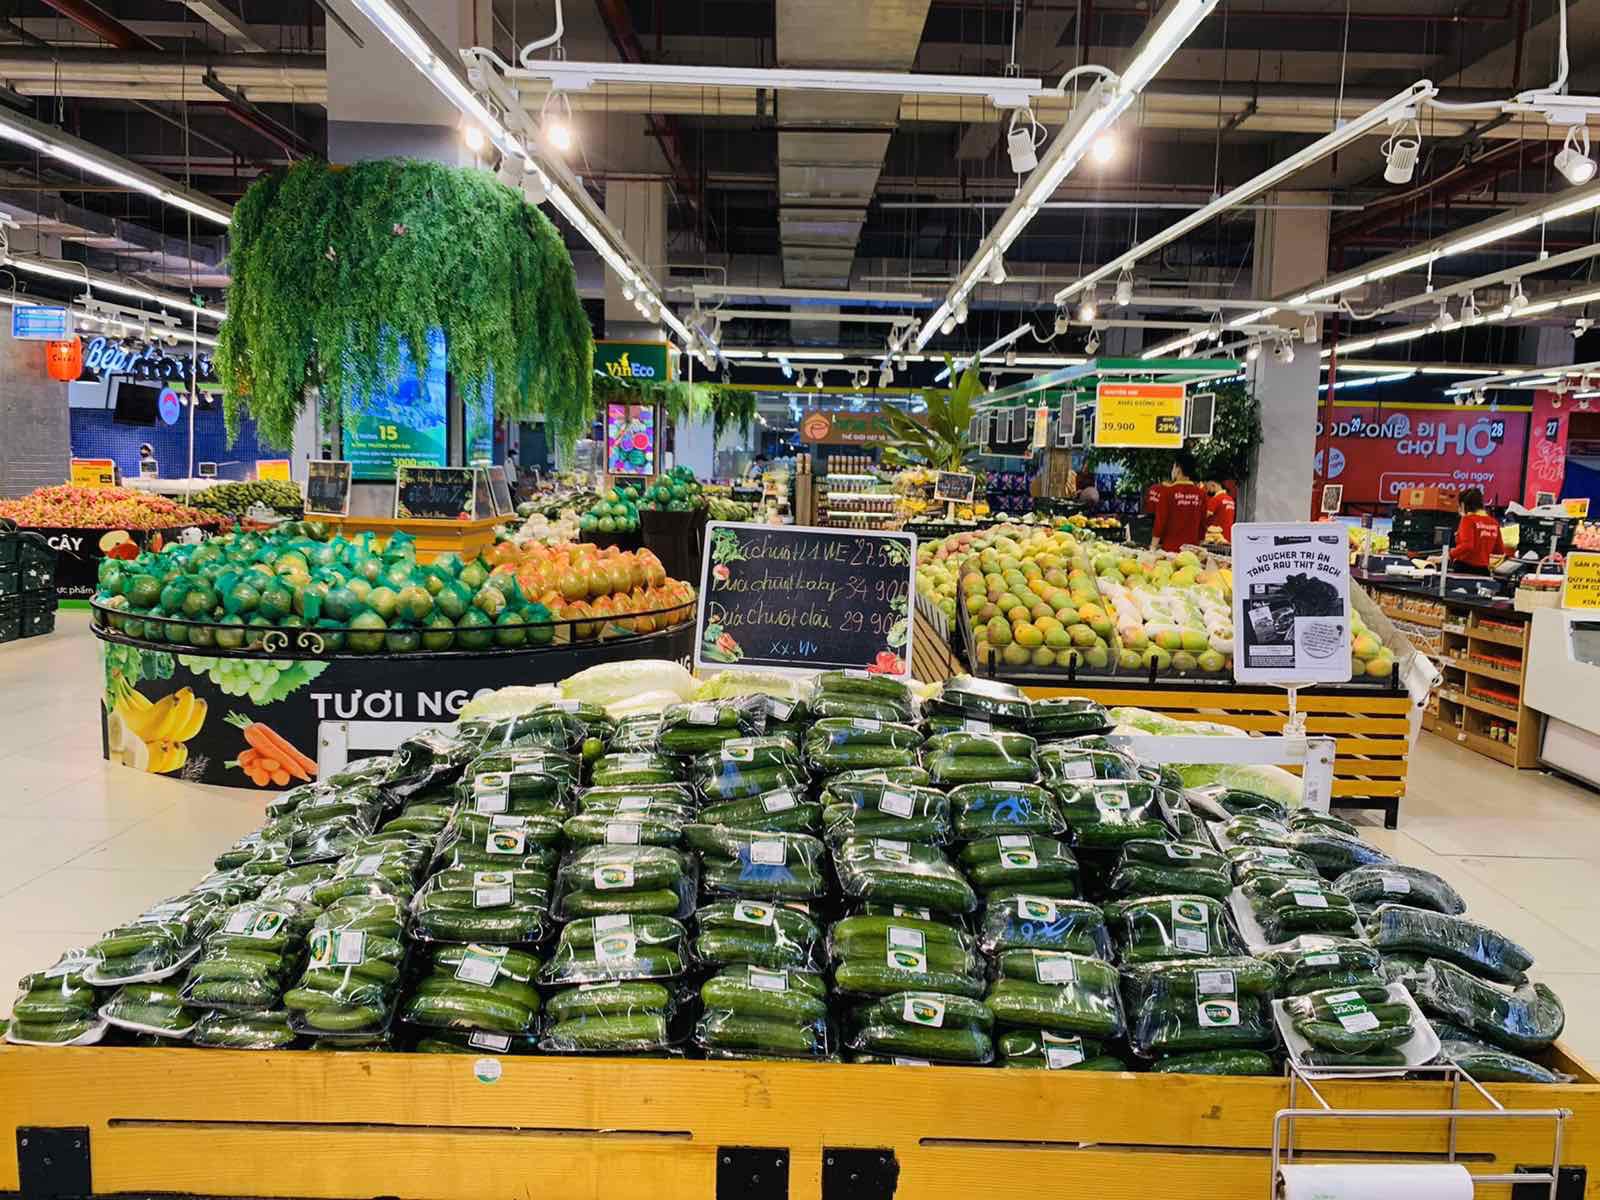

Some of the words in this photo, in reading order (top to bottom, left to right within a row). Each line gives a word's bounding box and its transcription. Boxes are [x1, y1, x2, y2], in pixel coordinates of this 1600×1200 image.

[605, 352, 655, 377] VinEco
[378, 424, 399, 441] 15
[1491, 422, 1504, 437] 28
[1545, 421, 1558, 437] 27
[47, 534, 83, 551] CÂY
[1256, 551, 1297, 564] VOUCHER
[1299, 551, 1315, 560] TRI
[1273, 561, 1291, 570] RAU
[309, 689, 404, 720] TƯƠI
